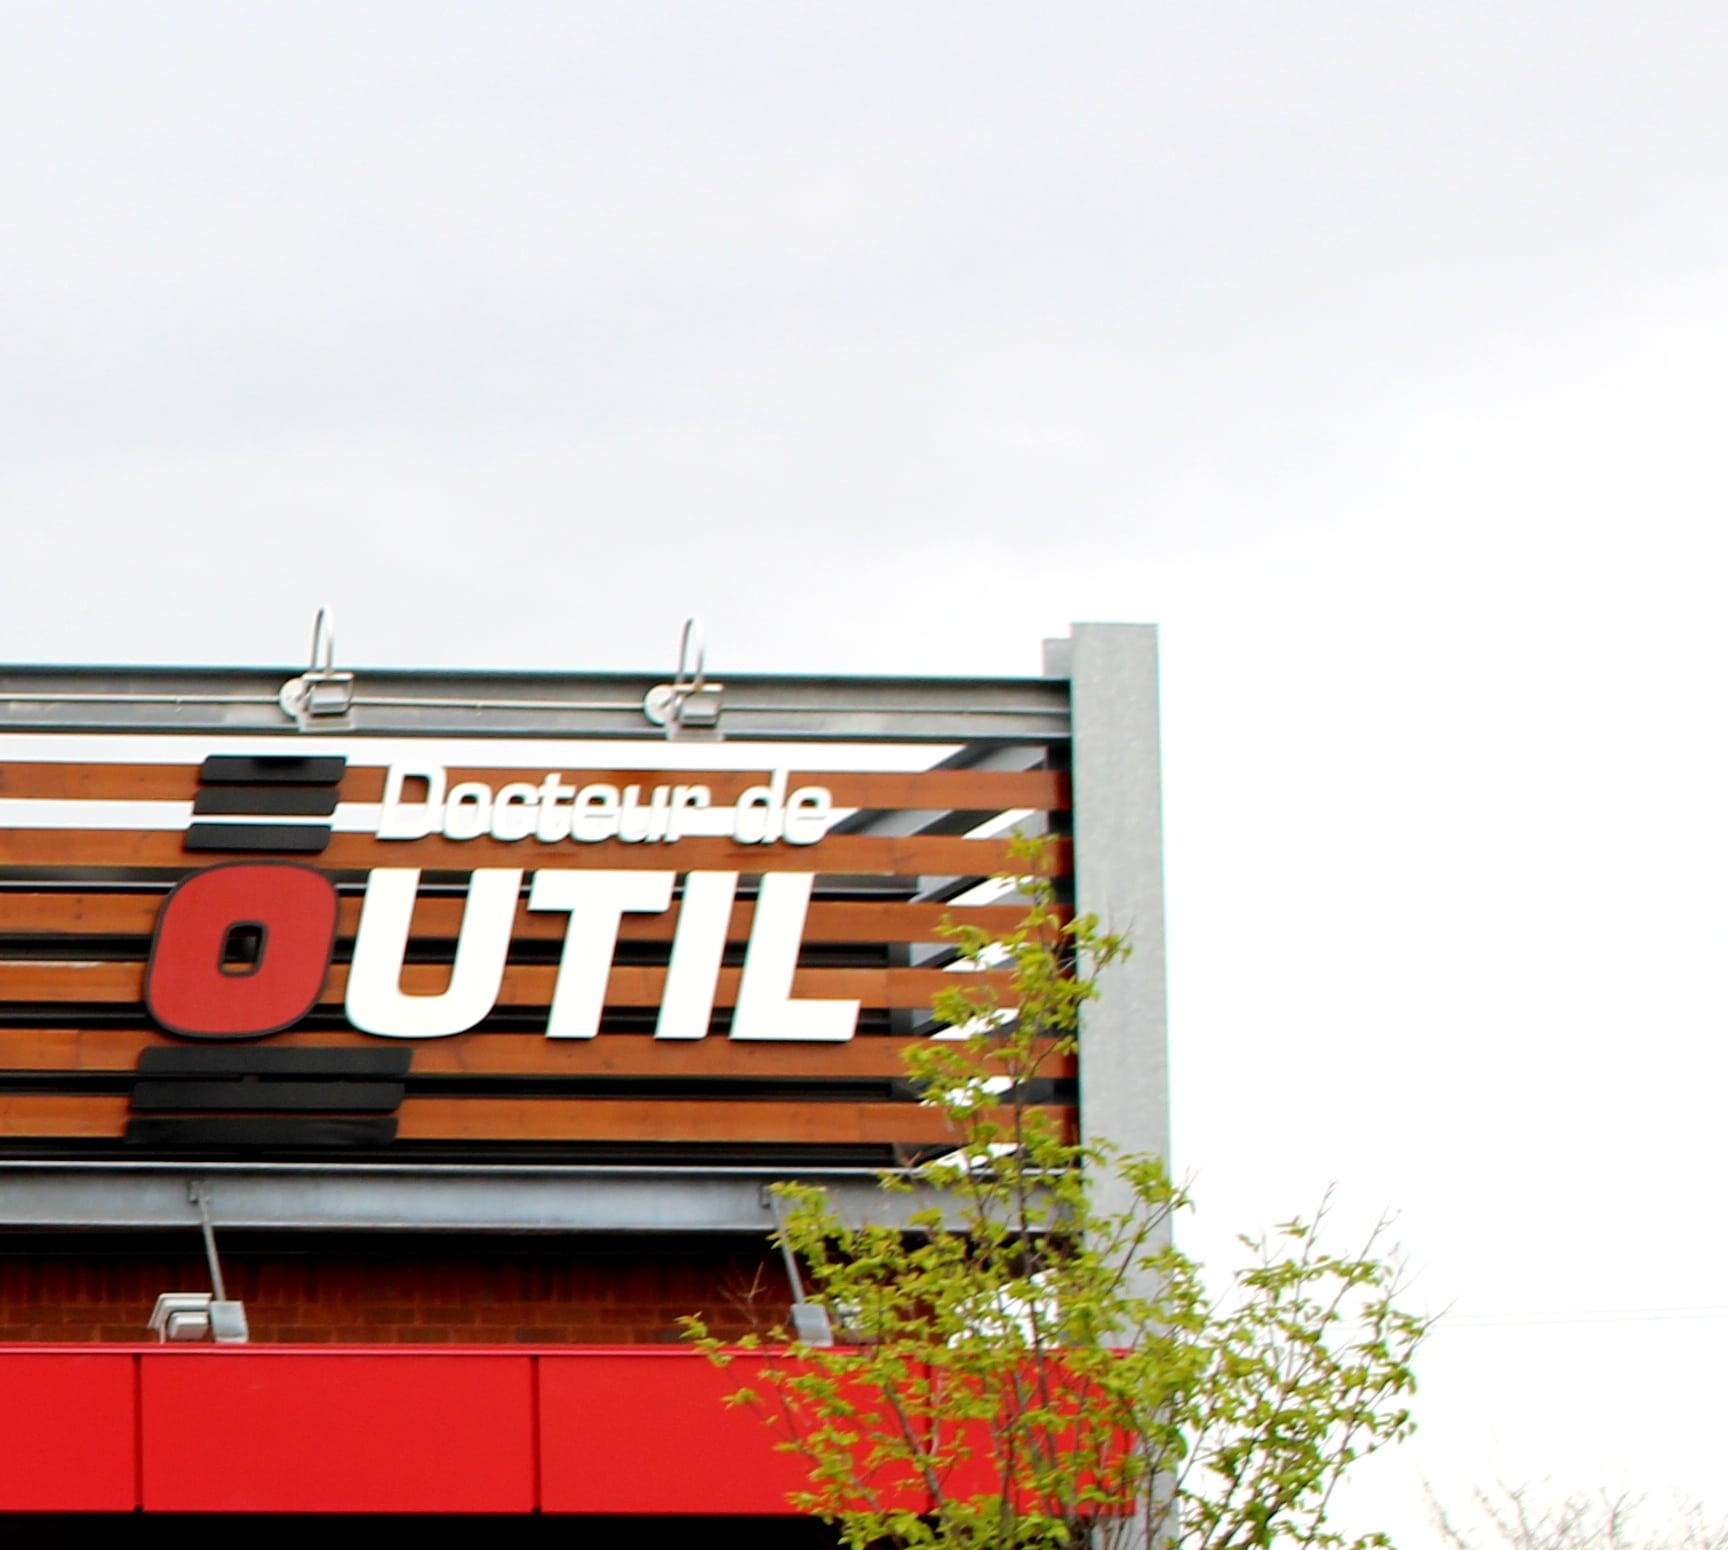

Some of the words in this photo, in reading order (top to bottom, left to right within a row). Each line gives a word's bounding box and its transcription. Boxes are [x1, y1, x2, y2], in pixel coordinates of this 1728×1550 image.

[376, 762, 710, 844] Docteur
[733, 767, 833, 845] de
[148, 861, 862, 1042] OUTIL
